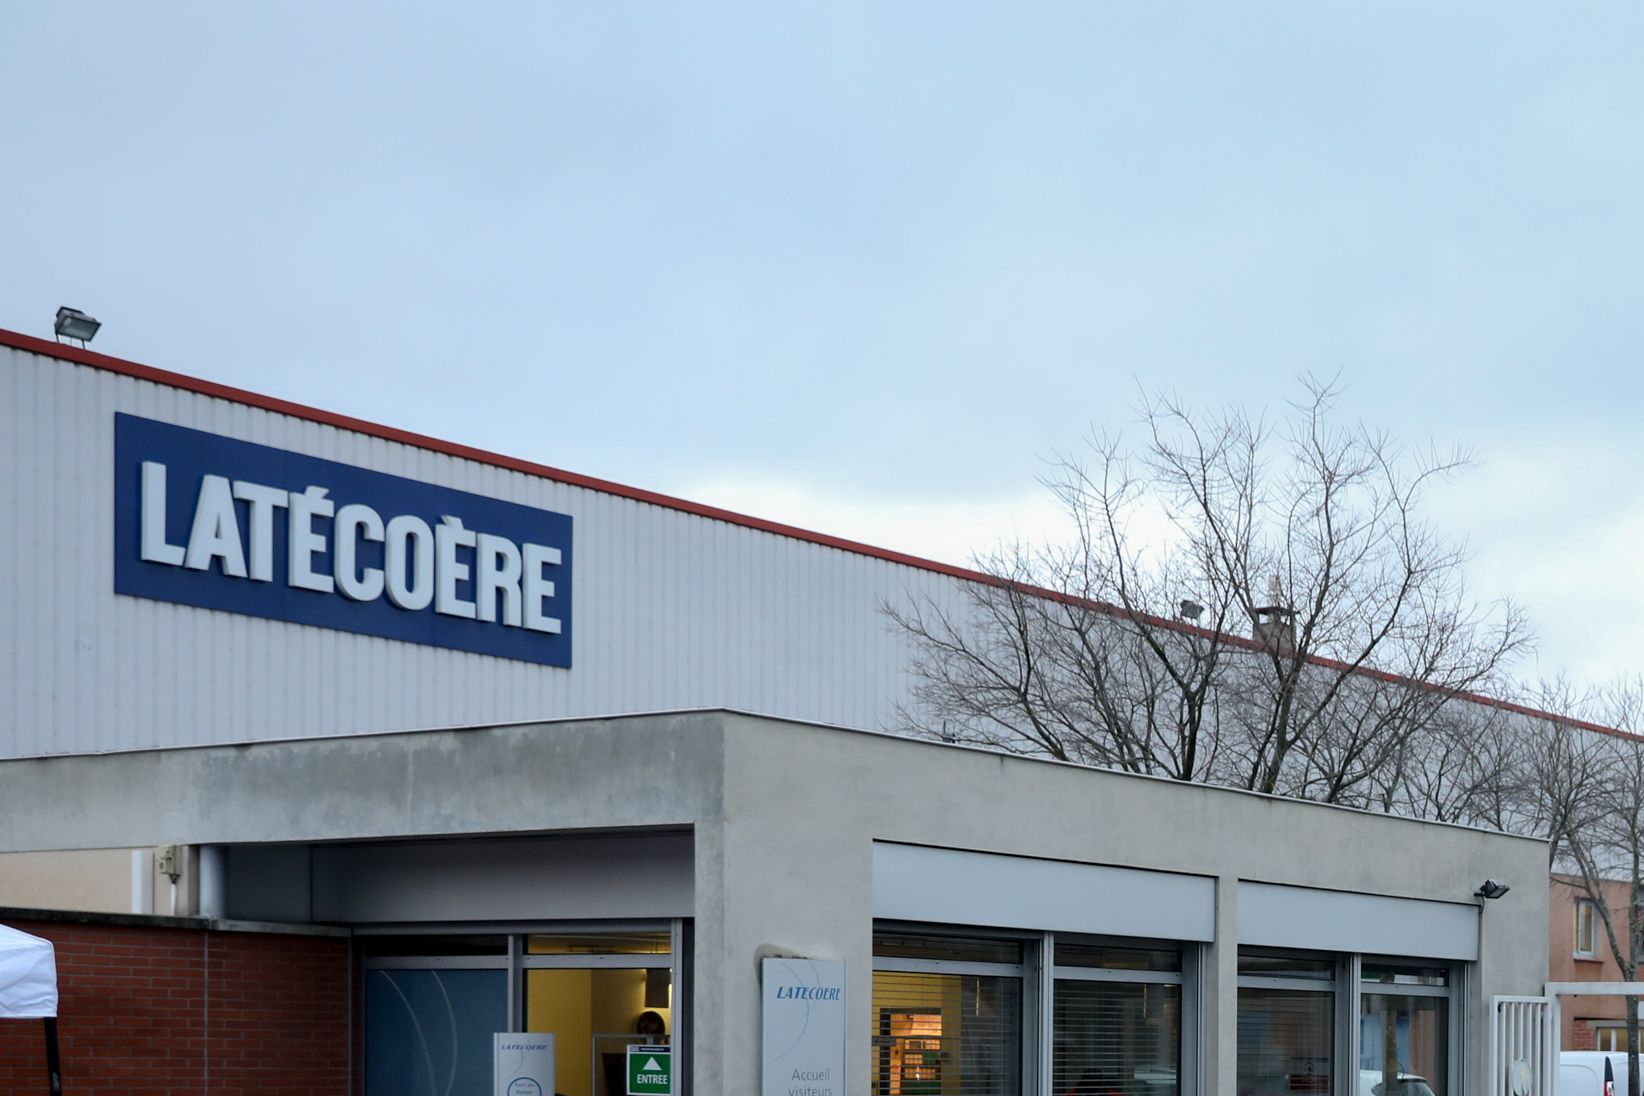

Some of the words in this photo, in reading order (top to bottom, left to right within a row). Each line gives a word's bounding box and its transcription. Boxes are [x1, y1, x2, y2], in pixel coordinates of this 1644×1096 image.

[141, 461, 562, 634] LATÉCOÈRE
[776, 986, 841, 1000] LATECOERE
[791, 1068, 830, 1081] Accueil
